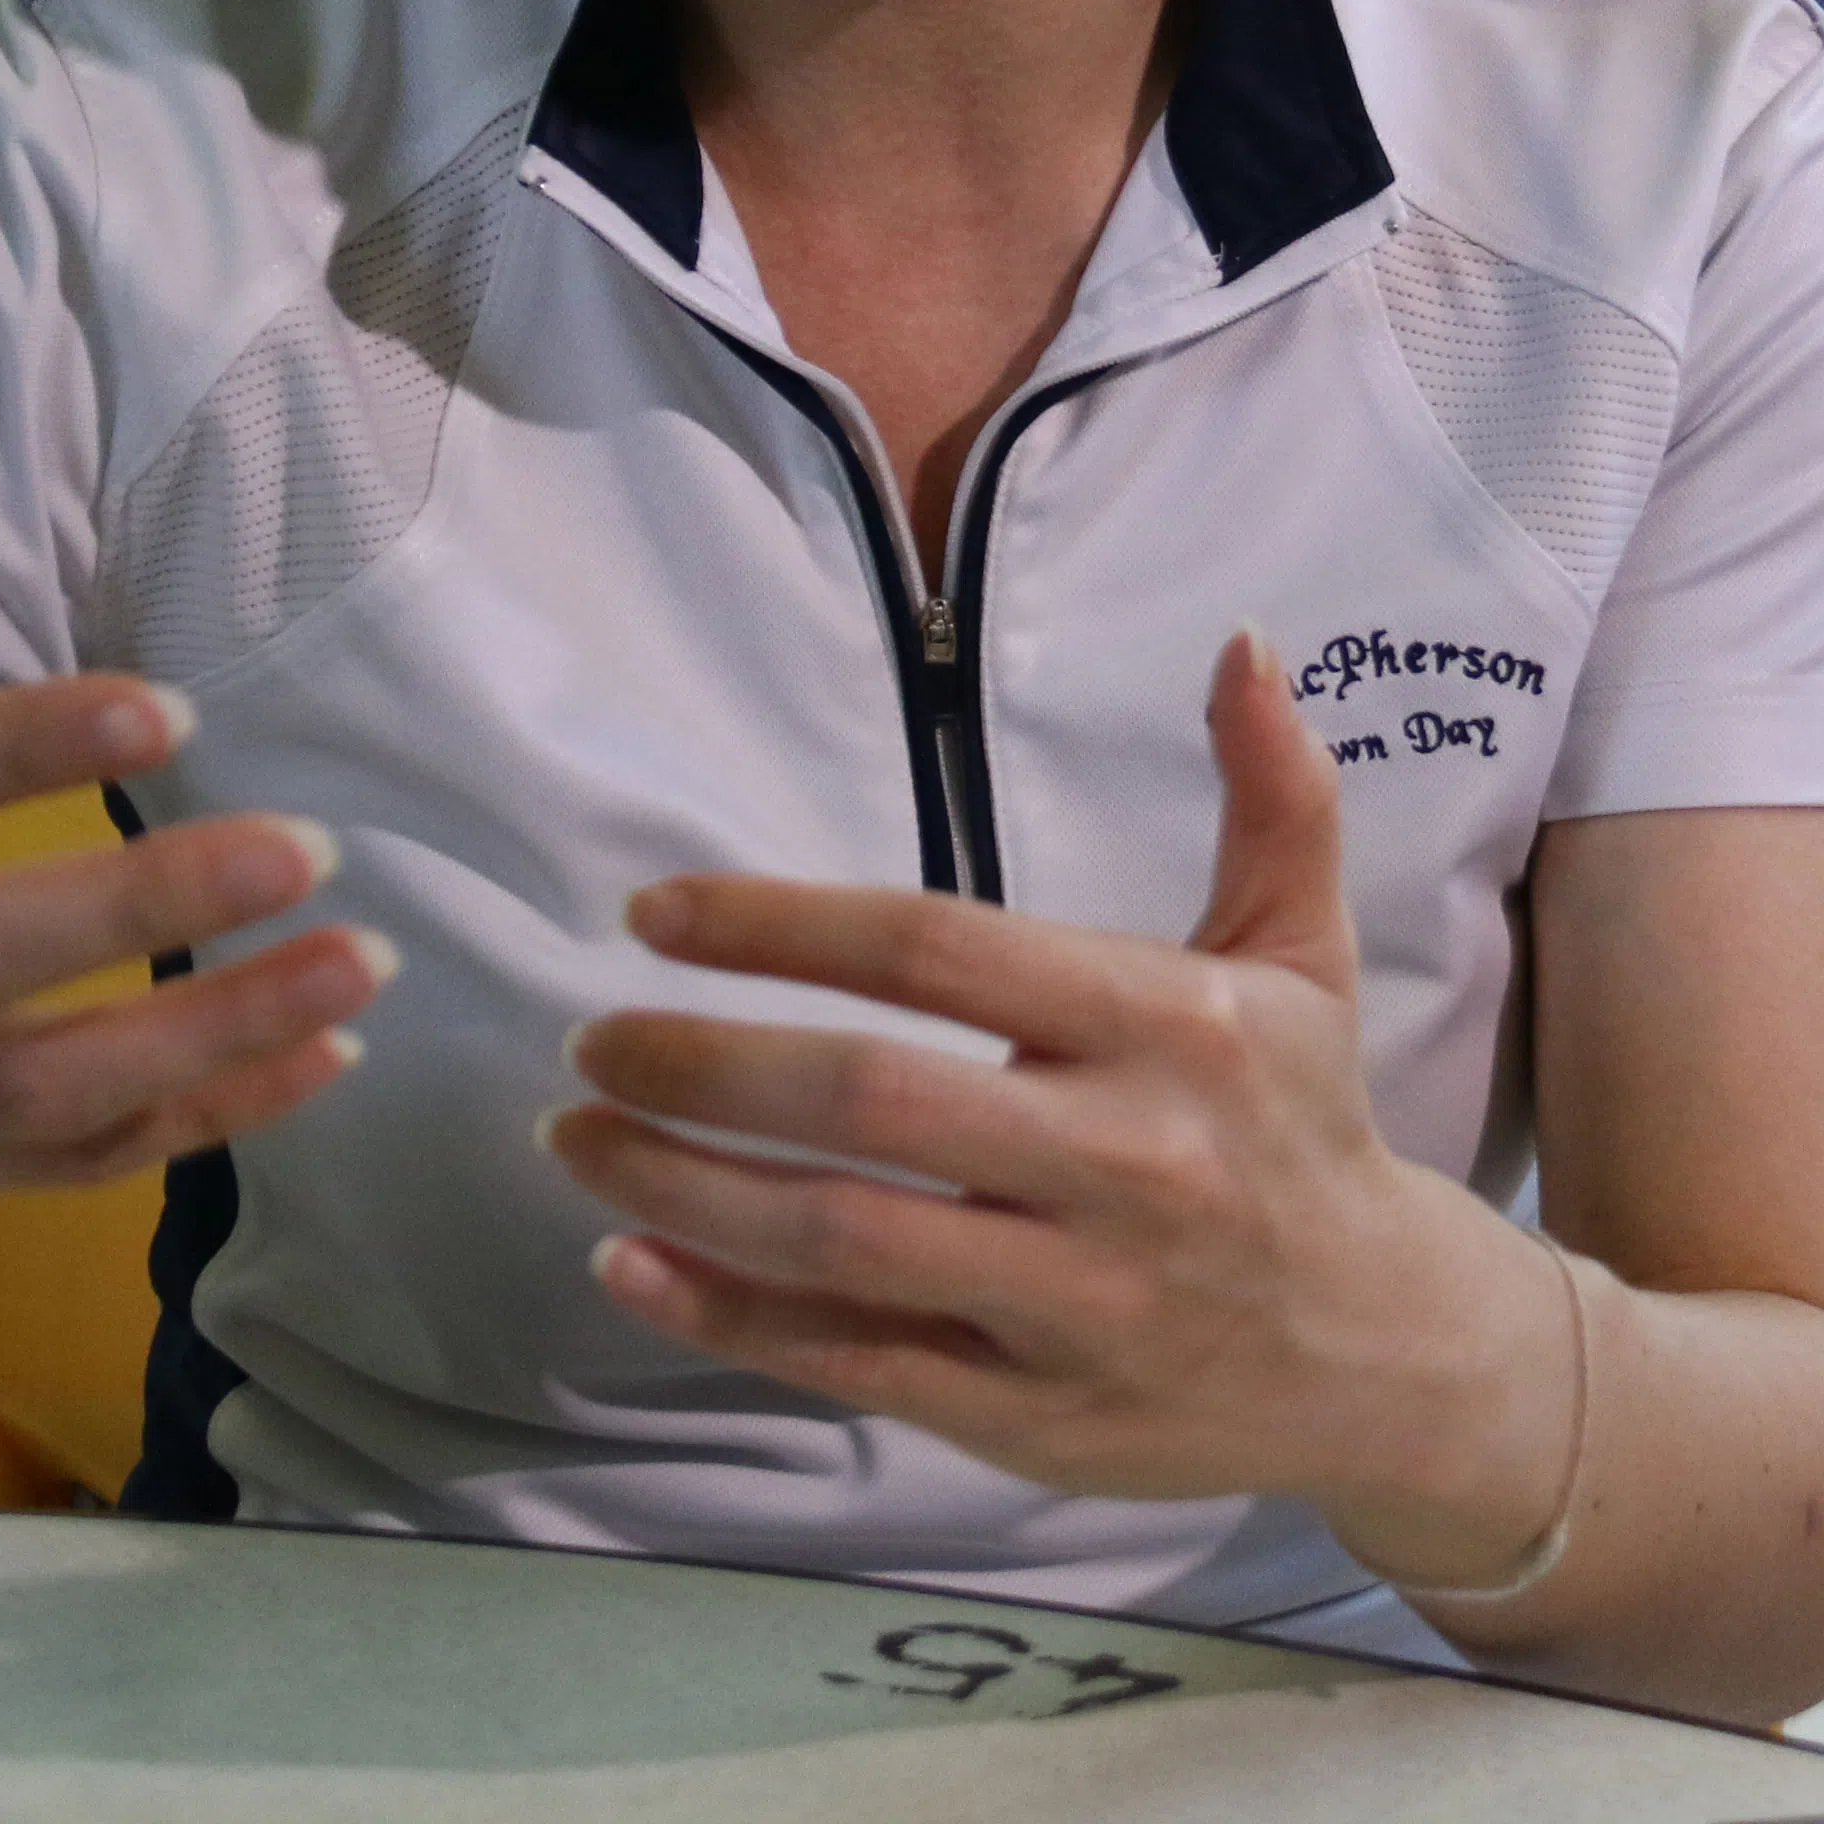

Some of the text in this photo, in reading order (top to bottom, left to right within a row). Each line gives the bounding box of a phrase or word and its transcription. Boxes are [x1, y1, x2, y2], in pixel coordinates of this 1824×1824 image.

[1288, 628, 1547, 702] cPherson
[1327, 710, 1499, 766] wn Day
